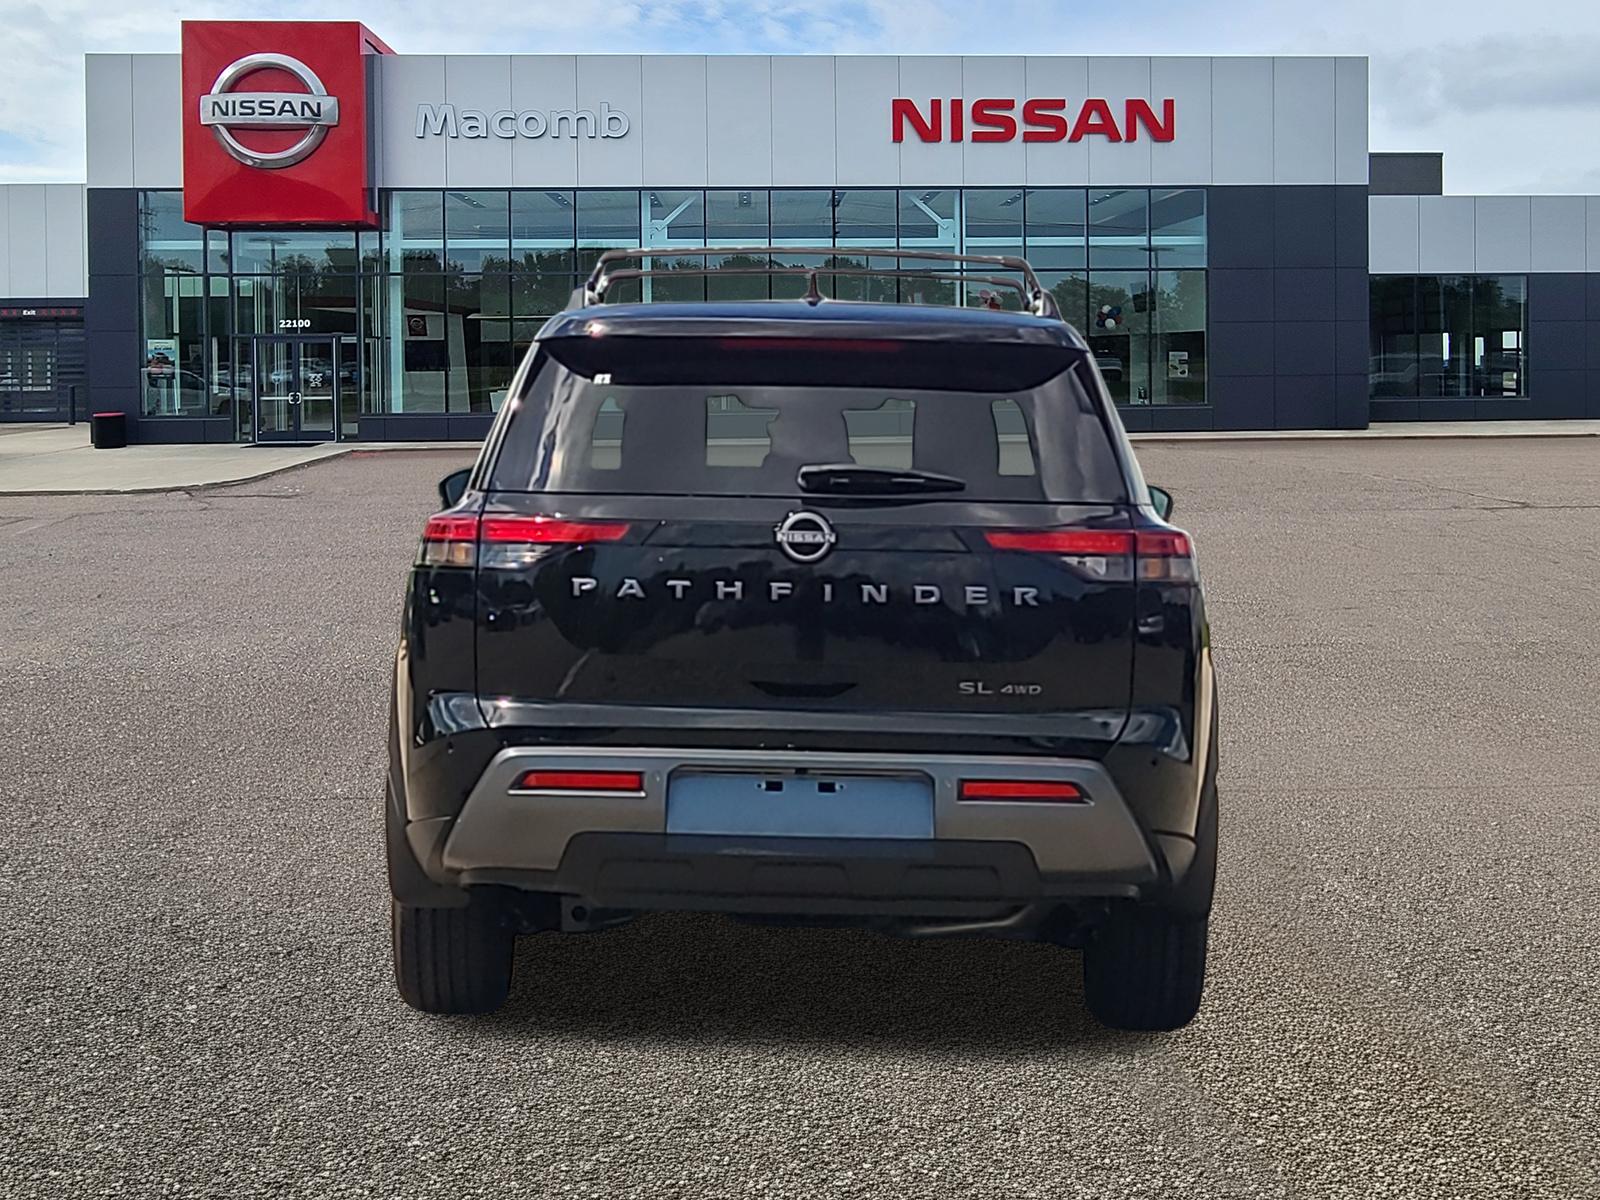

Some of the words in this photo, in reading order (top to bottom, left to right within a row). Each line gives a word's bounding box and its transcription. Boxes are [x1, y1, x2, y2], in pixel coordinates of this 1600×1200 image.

[211, 99, 322, 118] NISSAN
[415, 101, 630, 139] Macomb
[892, 98, 1175, 143] NISSAN
[279, 319, 311, 328] 22100
[776, 530, 836, 543] NISSAN
[571, 576, 1040, 607] PATHFINDER
[958, 681, 994, 695] SL
[1000, 683, 1043, 696] 4WD
